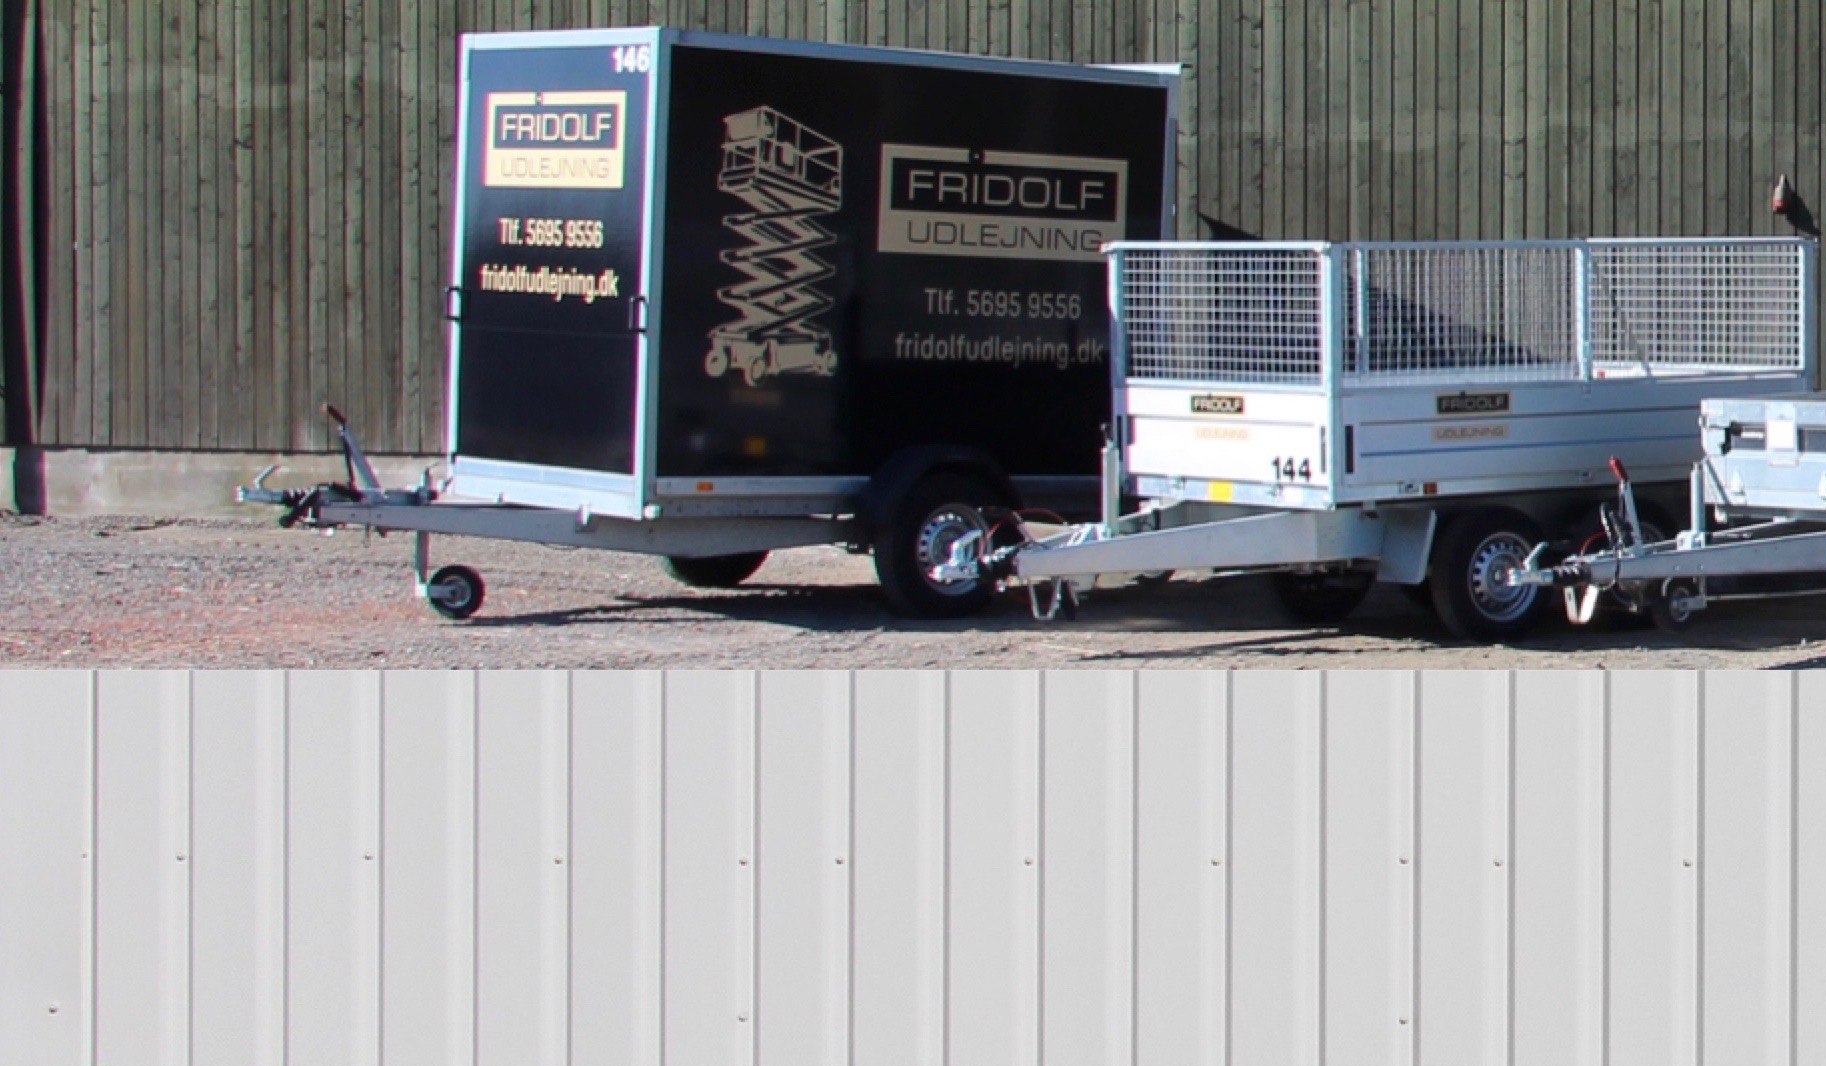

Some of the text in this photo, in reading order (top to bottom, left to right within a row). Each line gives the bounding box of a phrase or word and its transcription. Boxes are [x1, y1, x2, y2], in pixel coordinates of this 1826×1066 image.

[612, 47, 649, 73] 146
[501, 112, 612, 142] FRIDOLF
[500, 157, 610, 178] UDLEJNING
[908, 169, 1104, 210] FRIDOLF
[499, 218, 604, 248] Tlf. 5695 9556
[907, 219, 1104, 252] UDLEJNING
[480, 264, 619, 304] fridolfudlejning.dk
[924, 287, 1082, 320] Tlf. 5695 9556
[895, 331, 1104, 370] fridolfudlejning.dk
[1272, 456, 1312, 482] 144
